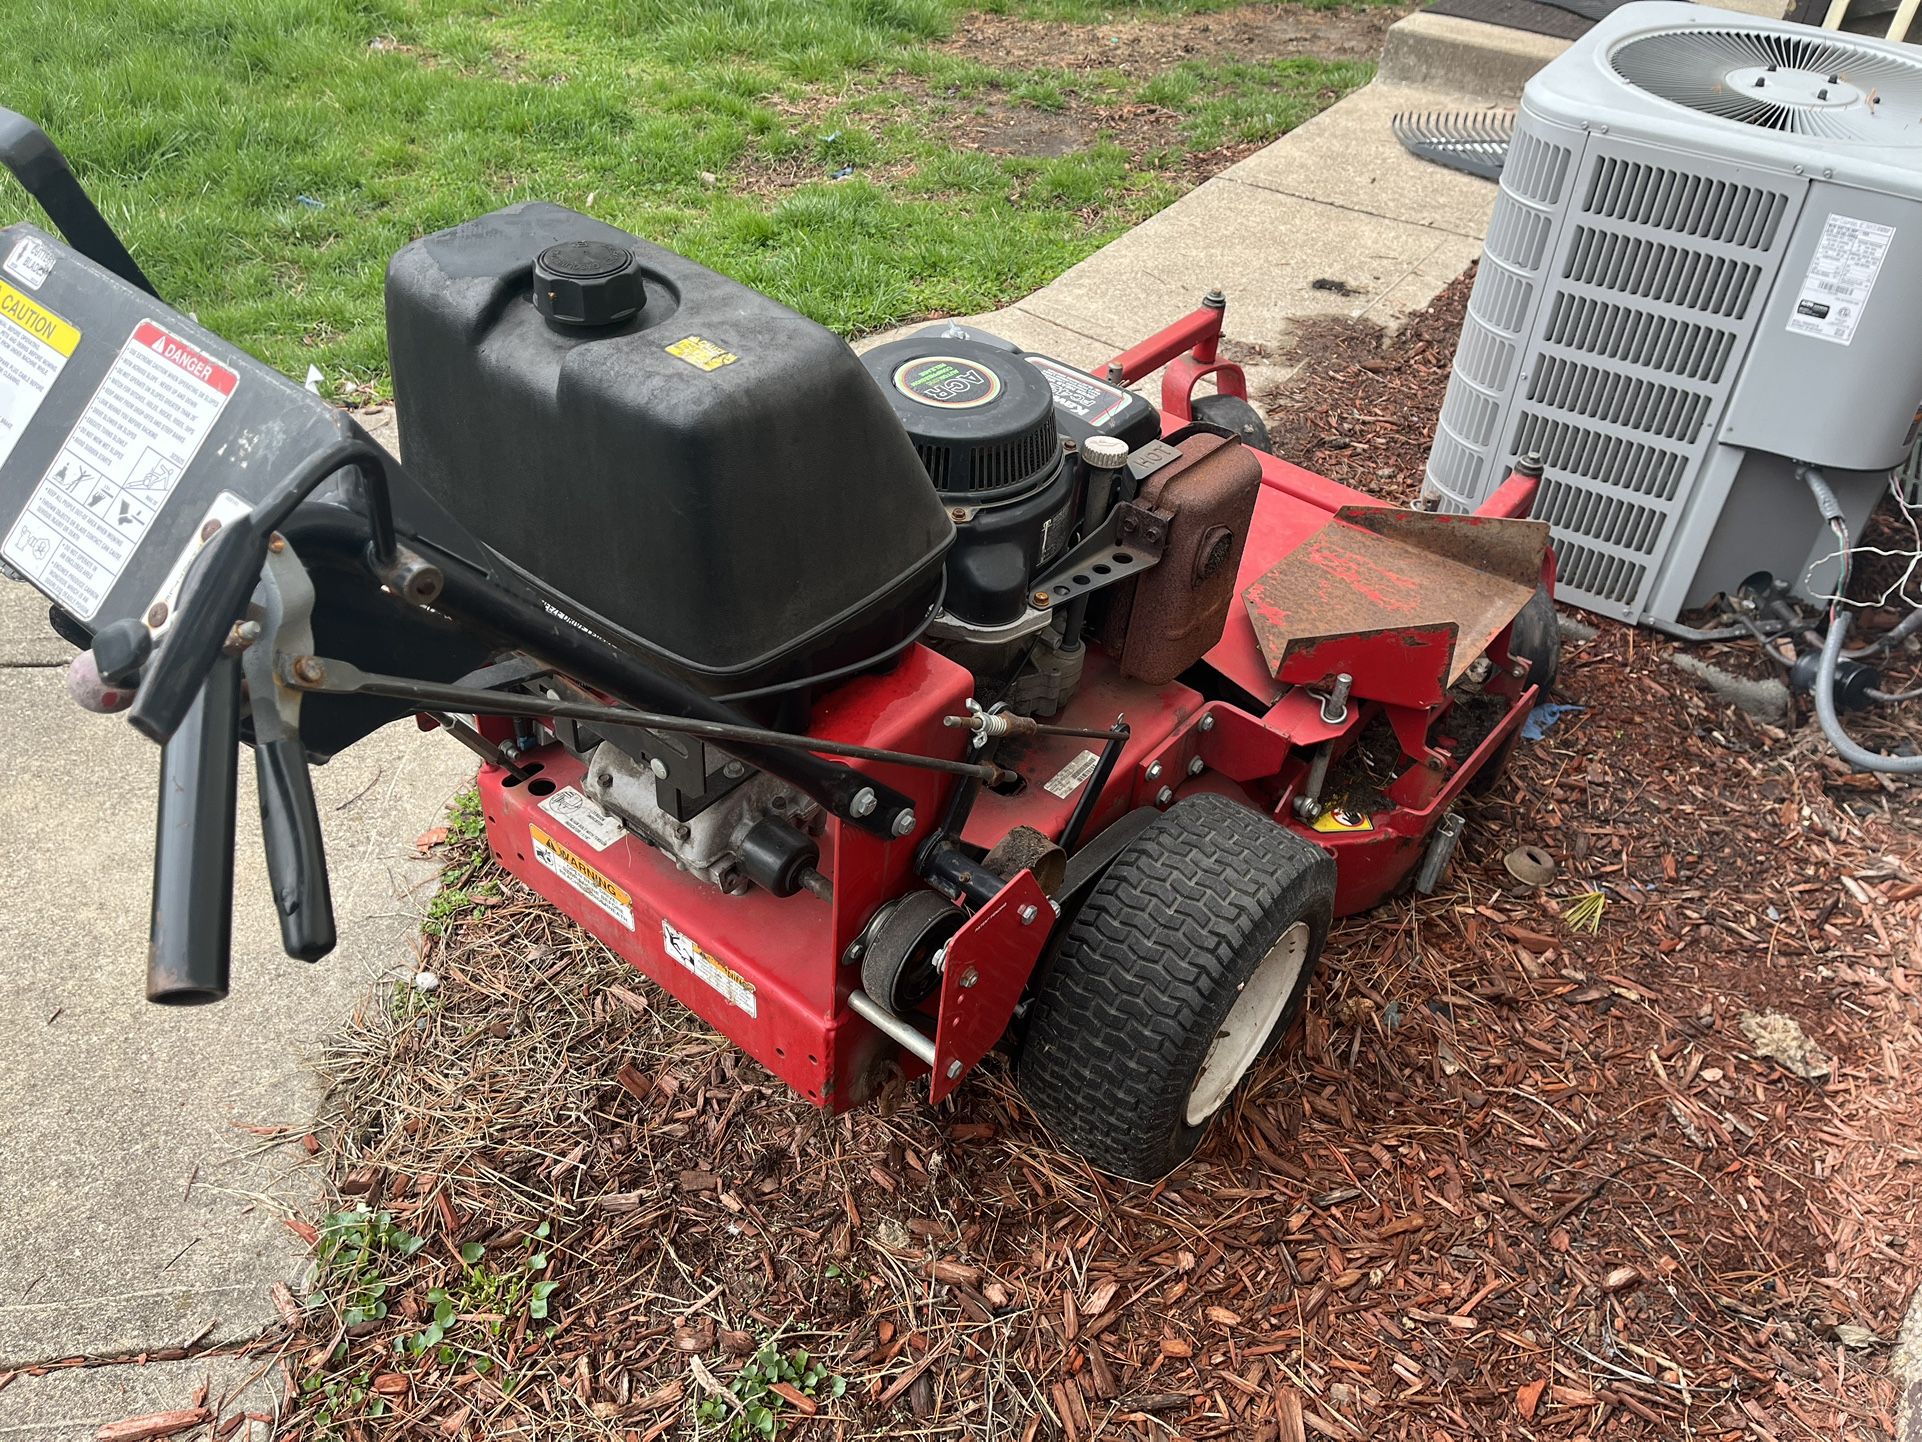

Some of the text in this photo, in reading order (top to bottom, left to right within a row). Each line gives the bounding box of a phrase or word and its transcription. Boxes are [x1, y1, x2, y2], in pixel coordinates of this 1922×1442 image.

[1, 294, 57, 339] CAUTION
[0, 339, 11, 351] FROM
[9, 345, 22, 358] UNDER
[20, 353, 37, 368] MACHINE
[8, 335, 17, 345] AND
[15, 340, 29, 353] DEBRIS
[28, 348, 43, 362] BEFORE
[163, 342, 213, 380] DANGER
[8, 363, 20, 375] PLUG
[17, 370, 31, 383] CABLE
[28, 378, 45, 392] BEFORE
[128, 347, 137, 355] USE
[135, 351, 153, 365] EXTREME
[151, 361, 168, 375] CAUTION
[166, 371, 179, 381] WHEN
[177, 378, 199, 394] OPERATING
[910, 366, 954, 387] COMPRESSION
[918, 362, 947, 377] RELEASE
[110, 376, 123, 388] WATCH
[122, 384, 131, 393] FOR
[121, 370, 131, 379] NOT
[129, 375, 146, 389] OPERATE
[149, 388, 165, 401] SLOPES
[163, 396, 181, 411] GREATER
[179, 407, 191, 418] THAN
[131, 363, 147, 376] ACROSS
[145, 372, 158, 383] SLOPE
[158, 380, 172, 392] NEVER
[176, 391, 186, 400] AND
[184, 396, 198, 408] DOWN
[924, 369, 984, 400] ACR
[0, 417, 13, 430] BRAKE
[97, 397, 158, 440] LOOK BEHIND YOU BEFORE BACKING
[102, 413, 118, 427] SLOWER
[116, 423, 123, 431] ON
[121, 426, 137, 440] SLOPES
[104, 386, 186, 443] KEEP AWAY FROM DROP-OFFS AND STEEP BANKS
[79, 426, 124, 460] DO NOT MOW WET SLOPES
[85, 416, 127, 447] EXECUTE TURNS SLOWLY
[73, 436, 85, 447] AVOID
[83, 443, 99, 456] SUDDEN
[1132, 445, 1171, 469] HOT
[36, 505, 52, 520] SERIOUS
[50, 515, 64, 529] INJURY
[62, 524, 69, 533] OR
[40, 497, 57, 512] THROWN
[54, 508, 71, 523] OBJECTS
[74, 522, 87, 535] BLADE
[85, 530, 102, 546] CONTACT
[100, 542, 110, 552] CAN
[108, 547, 122, 561] CAUSE
[46, 487, 57, 498] KEEP
[54, 493, 63, 502] ALL
[61, 498, 76, 512] PEOPLE
[86, 516, 97, 528] AREA
[95, 523, 108, 535] WHEN
[106, 531, 123, 547] MOWING
[59, 551, 66, 559] AN
[64, 555, 84, 573] ENCLOSED
[63, 543, 71, 552] DO
[69, 547, 78, 557] NOT
[76, 552, 93, 569] OPERATE
[53, 561, 99, 600] ENGINES PRODUCE CARBON
[66, 583, 80, 596] WHICH
[61, 590, 76, 604] DEADLY
[74, 600, 89, 615] POISON
[564, 820, 581, 833] INDICATOR
[586, 813, 604, 826] INDICATOR
[591, 810, 605, 821] TENSION
[584, 829, 594, 837] WITH
[592, 835, 606, 846] TENSION
[559, 847, 617, 897] WARNING
[601, 893, 624, 914] BEFORE
